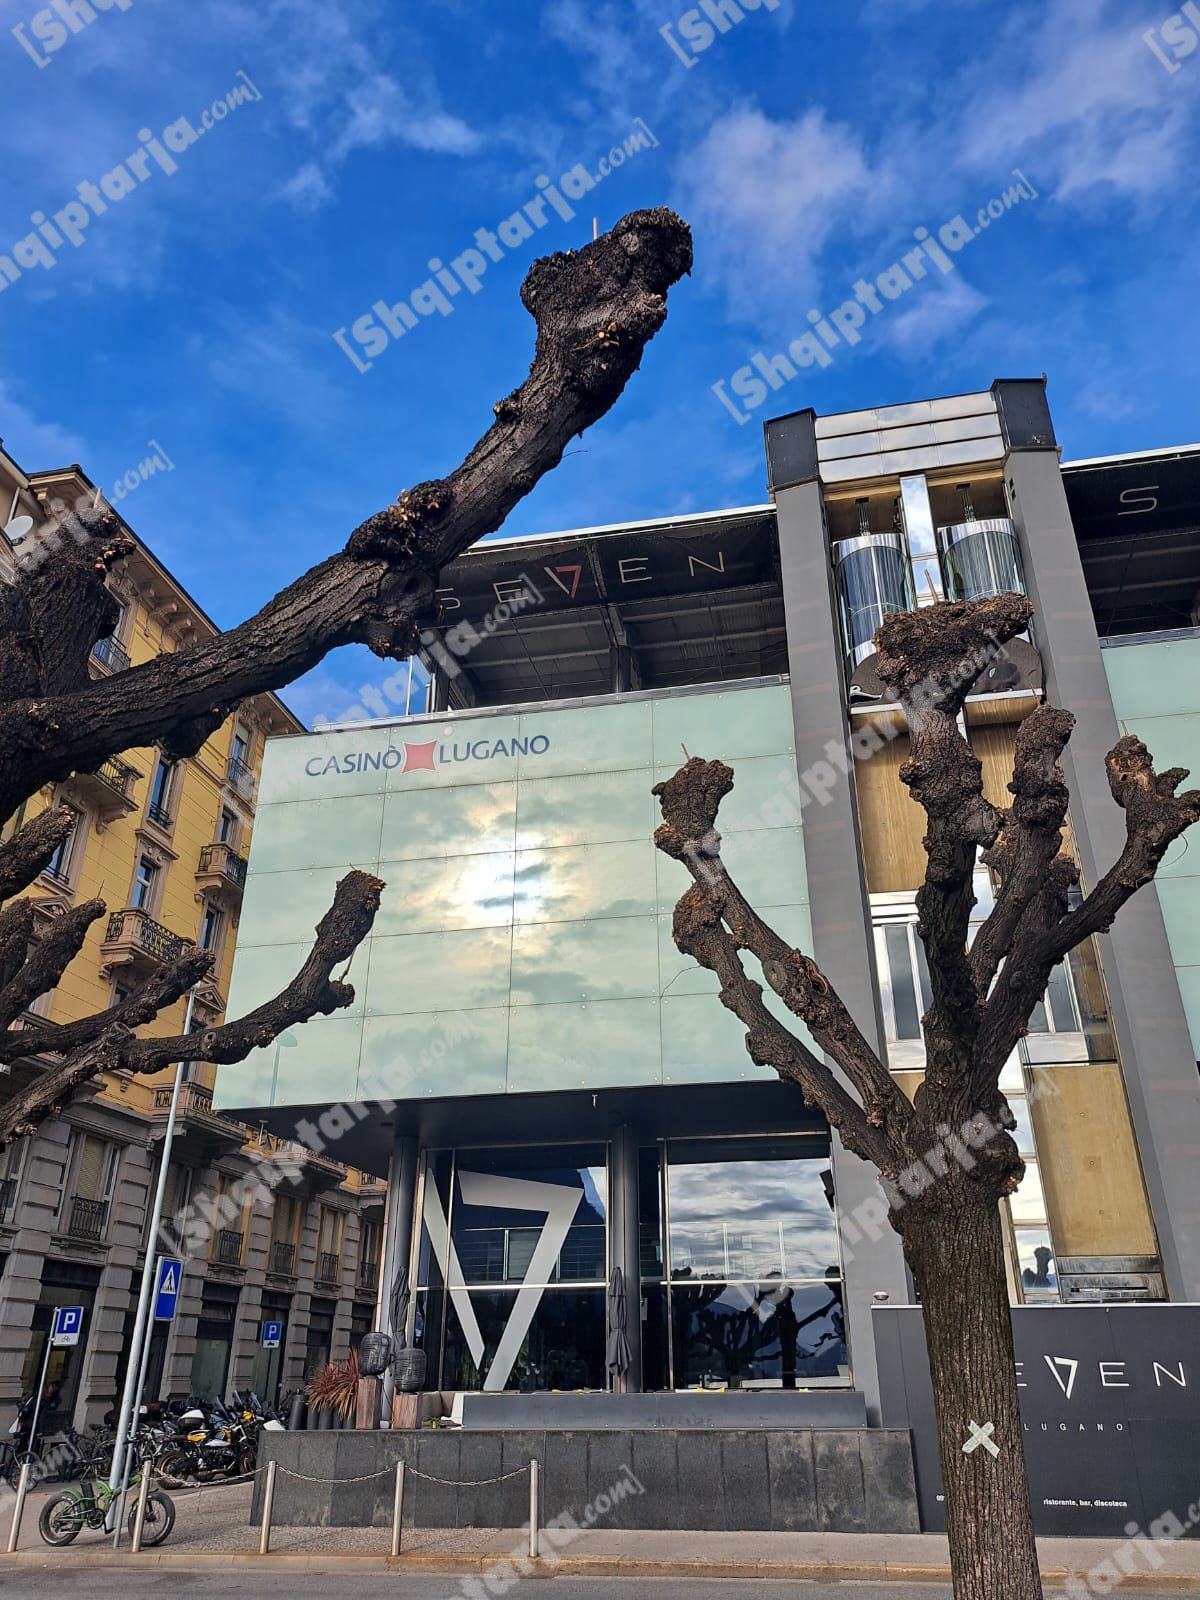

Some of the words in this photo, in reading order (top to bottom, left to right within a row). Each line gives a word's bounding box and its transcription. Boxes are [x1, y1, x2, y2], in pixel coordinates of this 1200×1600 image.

[304, 745, 402, 777] CASINÒ
[439, 735, 550, 764] LUGANO
[63, 1312, 76, 1331] P
[268, 1324, 277, 1338] P
[1023, 1423, 1123, 1431] LUGANO
[1043, 1498, 1078, 1507] ristorante,
[1079, 1499, 1093, 1507] bar,
